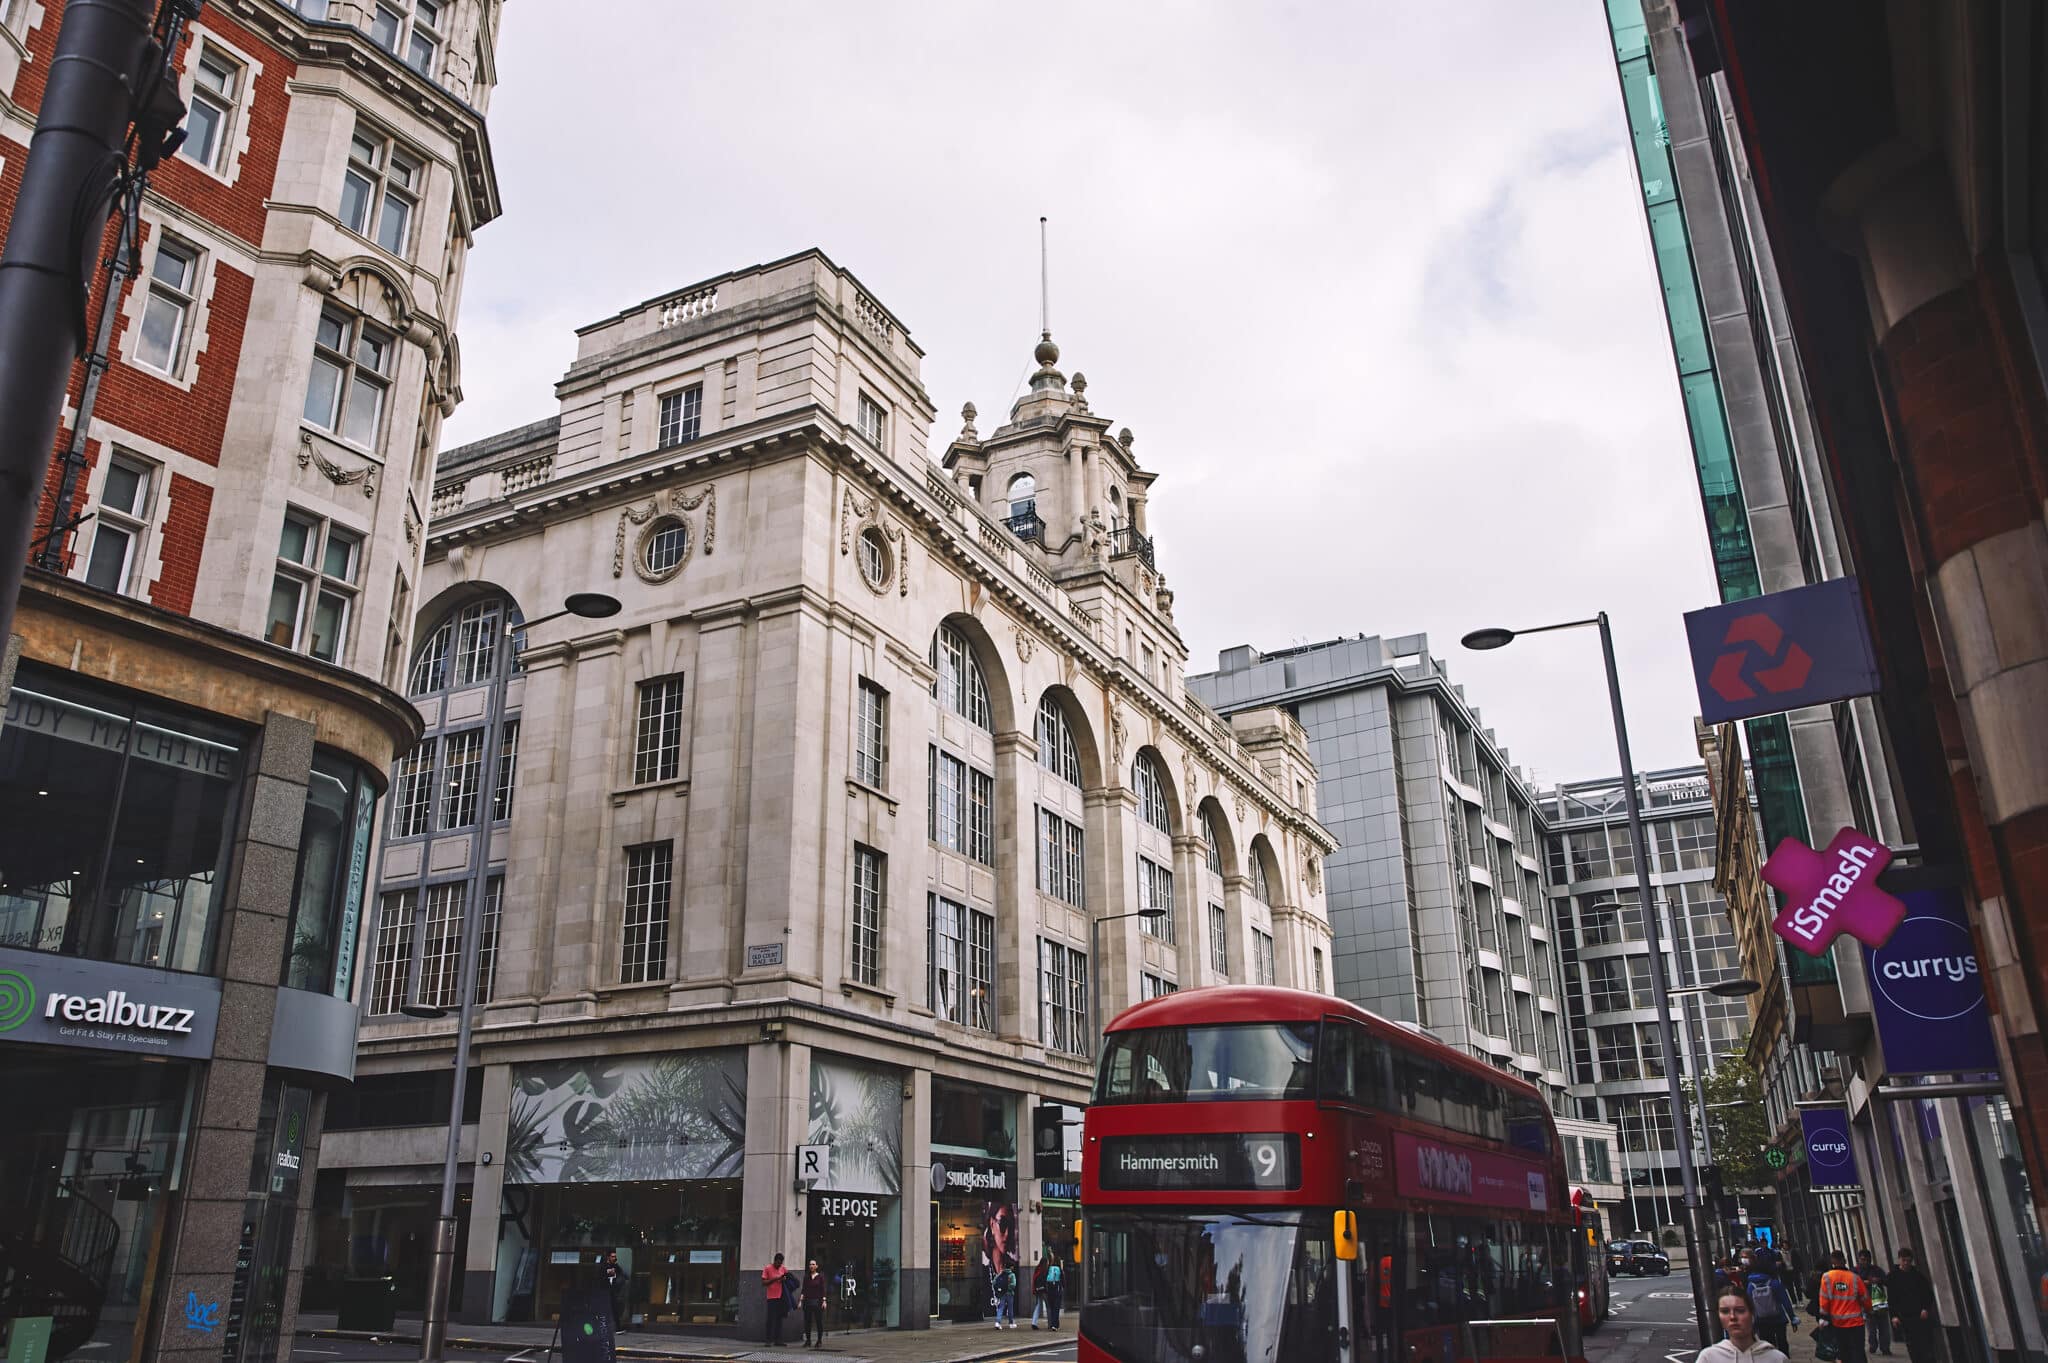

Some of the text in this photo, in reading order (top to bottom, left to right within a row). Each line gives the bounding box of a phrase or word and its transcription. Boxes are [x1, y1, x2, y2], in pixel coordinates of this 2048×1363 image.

[90, 719, 230, 776] MACHINE
[1671, 789, 1709, 801] HOTEL
[1786, 845, 1875, 941] iSmash
[1883, 955, 1978, 982] currys
[44, 990, 195, 1033] realbuzz
[59, 1027, 75, 1035] Get
[76, 1028, 87, 1037] Fit
[98, 1031, 115, 1041] Stay
[116, 1032, 127, 1040] Fit
[127, 1034, 168, 1046] Specialists
[1811, 1143, 1847, 1153] currys
[277, 1149, 300, 1169] realbuzz
[1120, 1144, 1277, 1177] Hammersmith 9
[1042, 1182, 1071, 1198] URBAN
[821, 1197, 879, 1217] REPOSE
